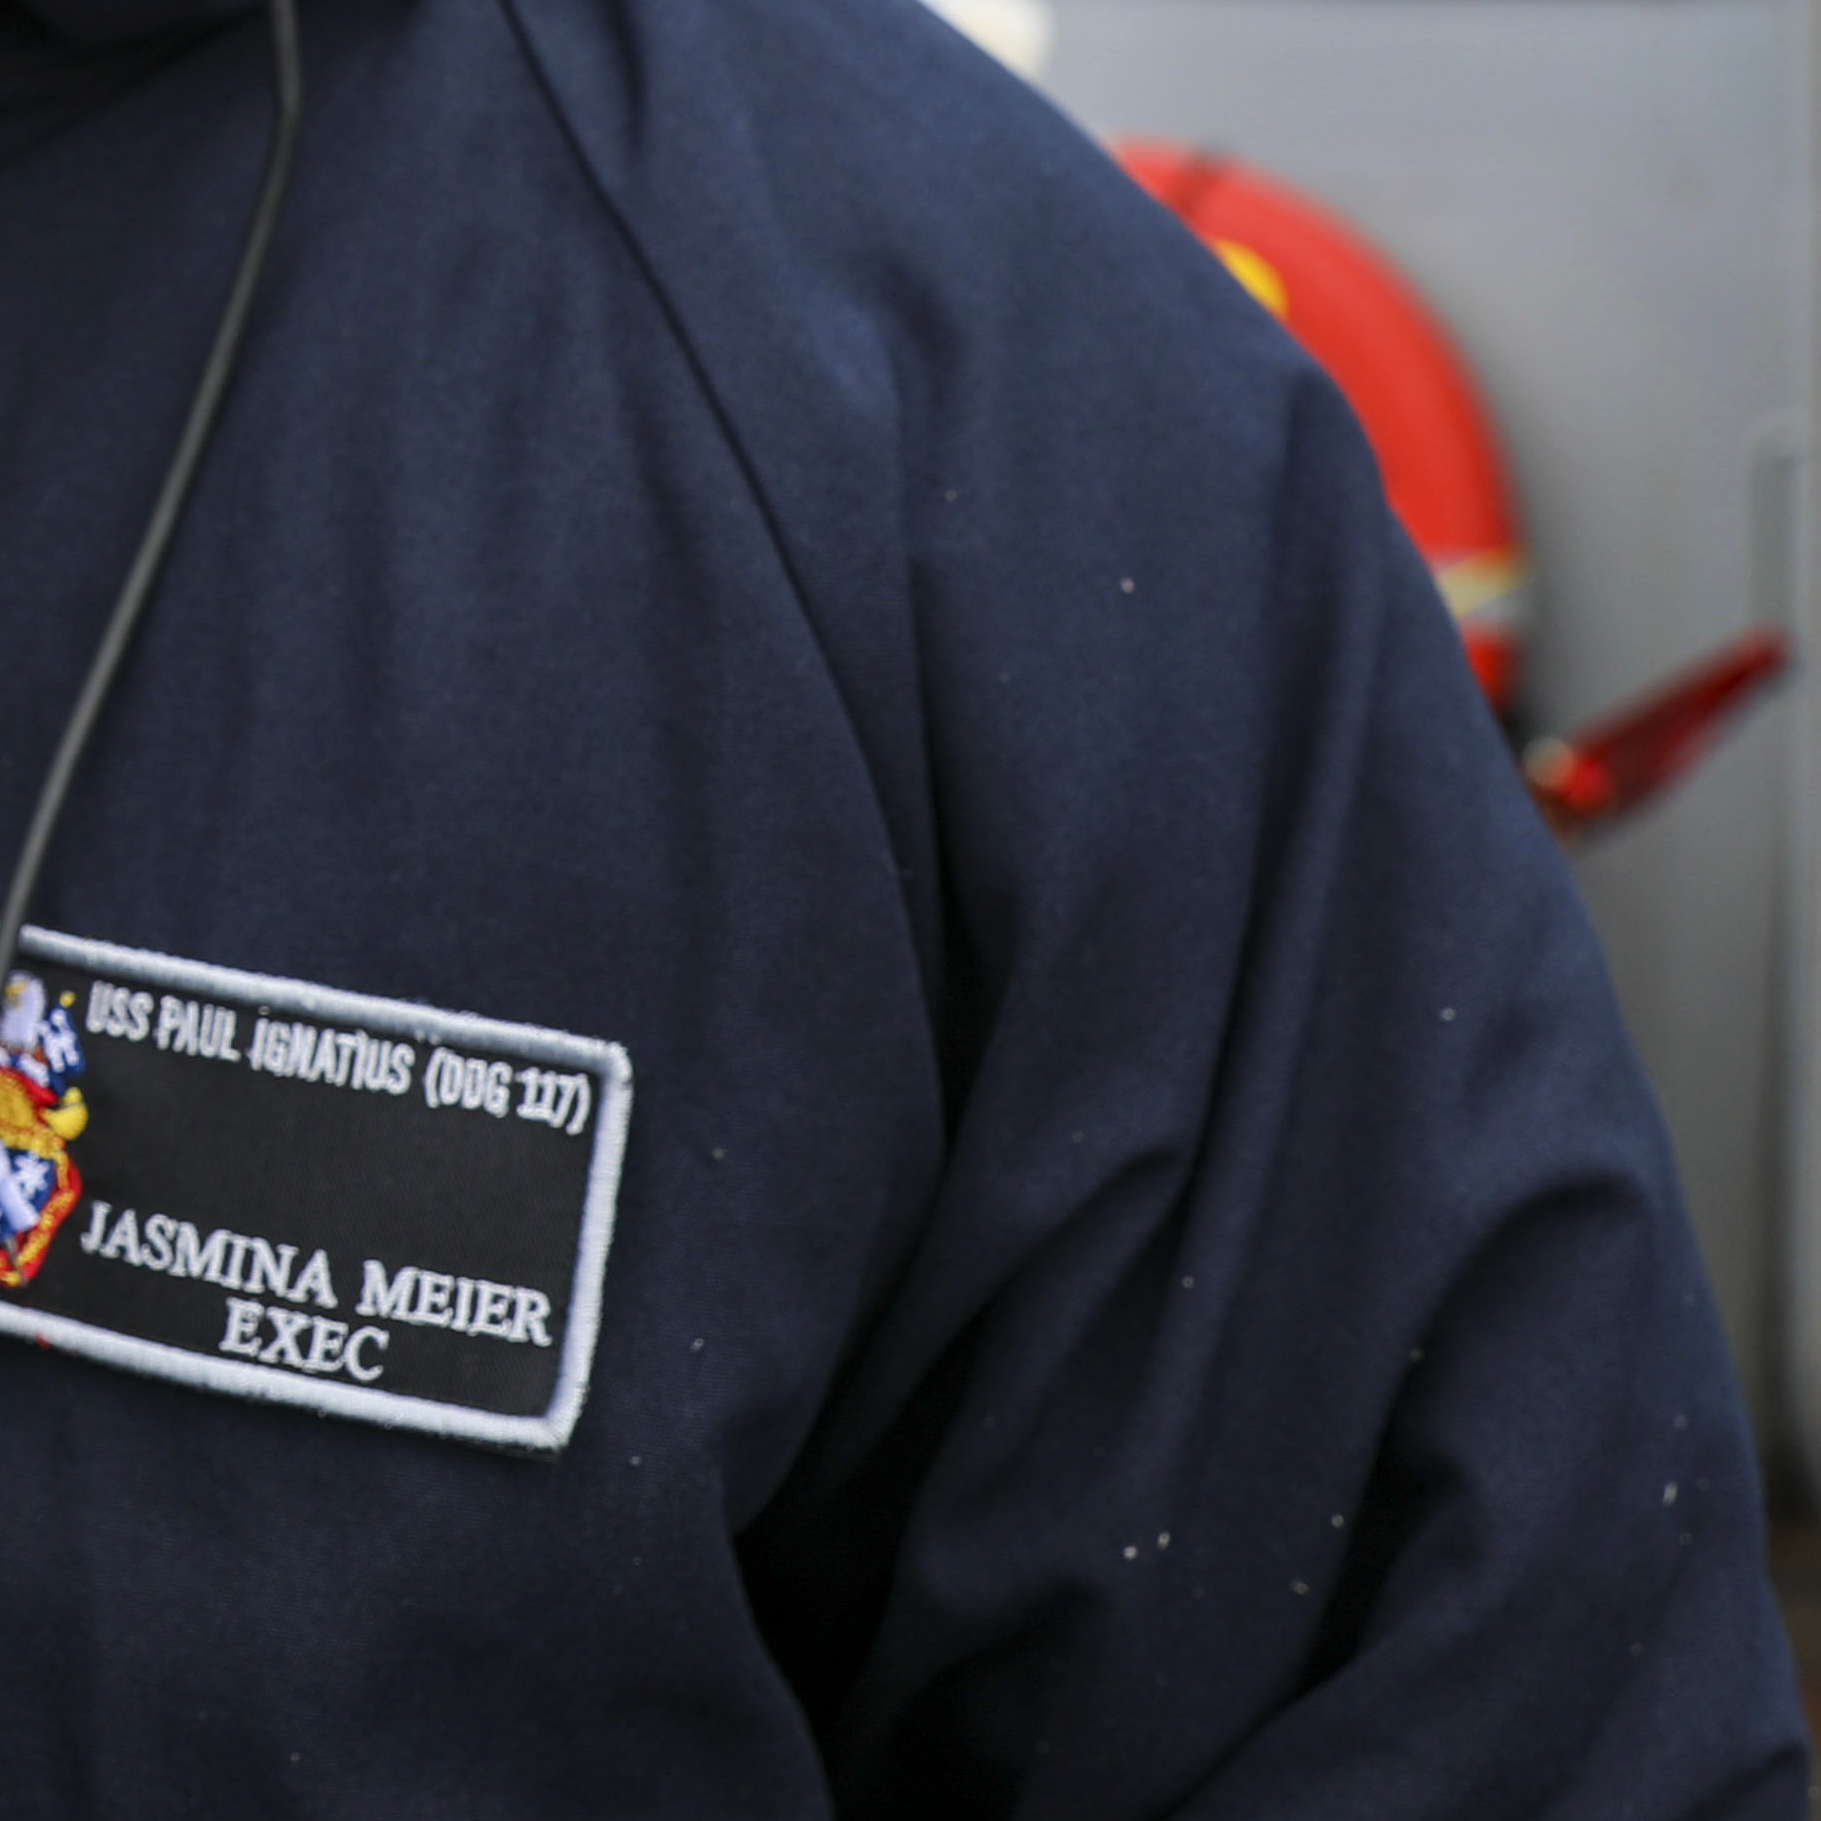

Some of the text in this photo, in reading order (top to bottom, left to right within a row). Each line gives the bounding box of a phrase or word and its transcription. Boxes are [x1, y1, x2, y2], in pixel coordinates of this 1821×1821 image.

[85, 980, 591, 1136] USS PAUL IGNATIUS (DDG 117)
[80, 1200, 553, 1347] JASMINA MEIER
[219, 1296, 390, 1381] EXEC
